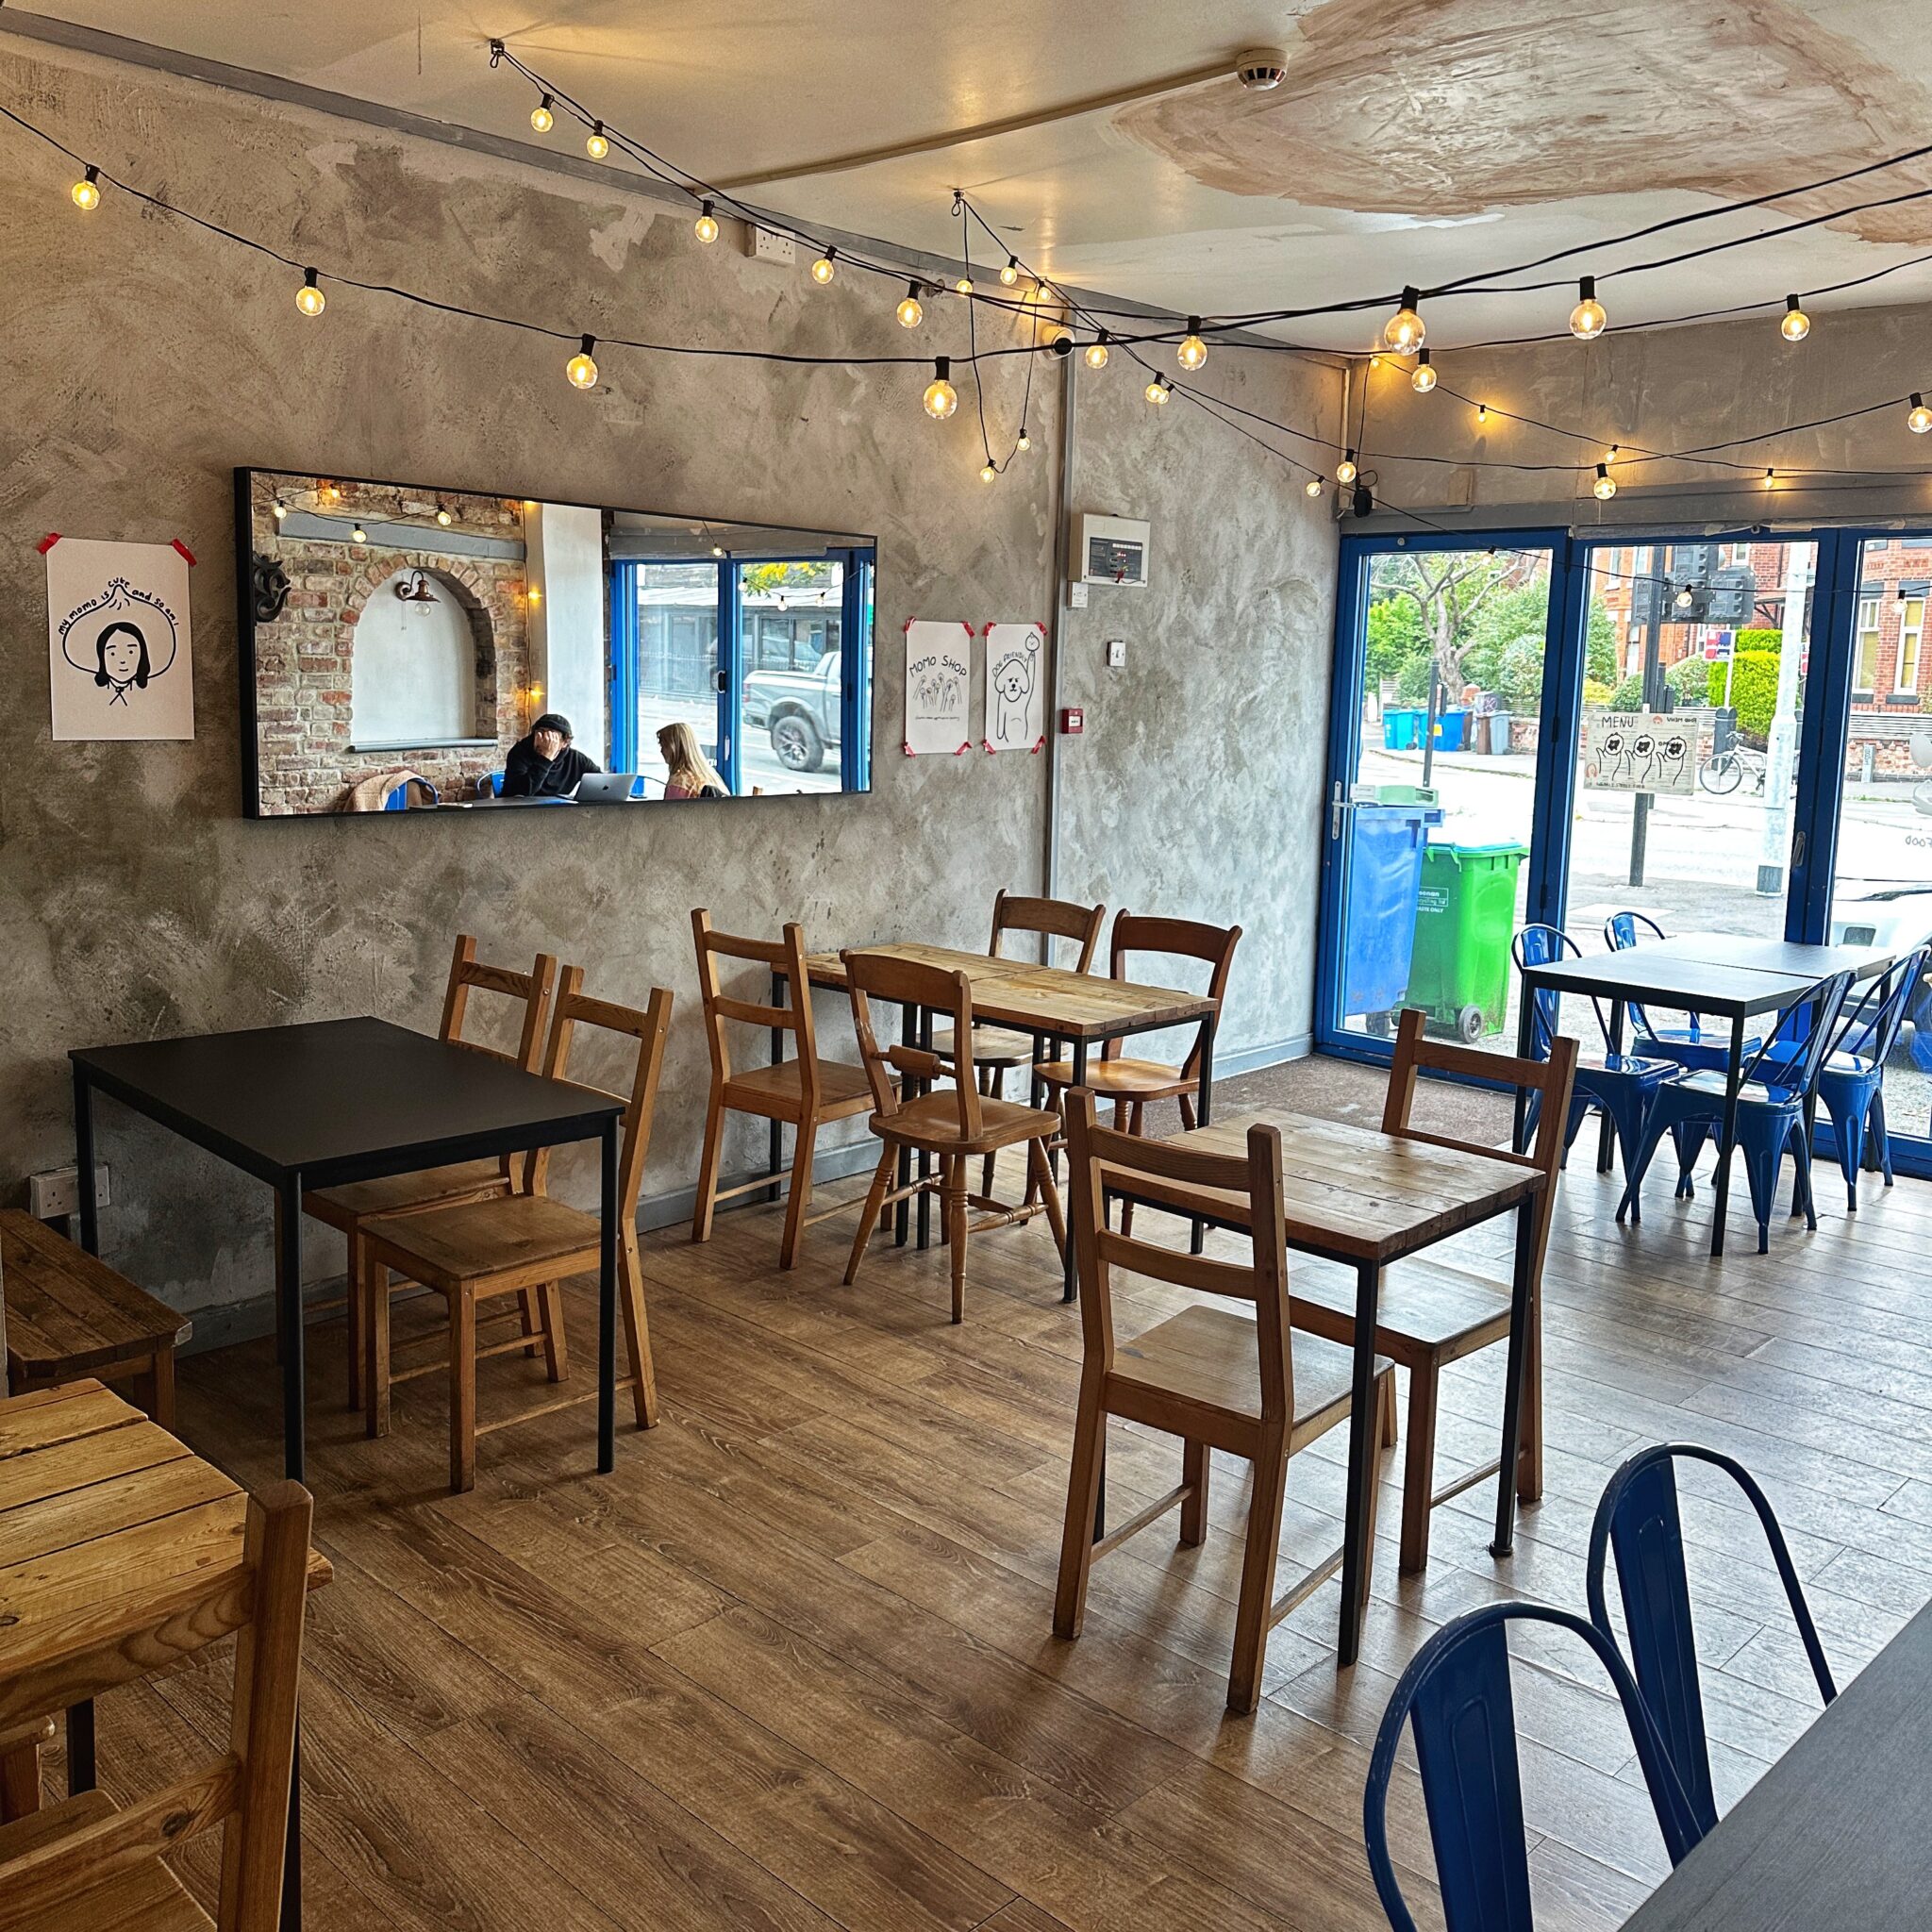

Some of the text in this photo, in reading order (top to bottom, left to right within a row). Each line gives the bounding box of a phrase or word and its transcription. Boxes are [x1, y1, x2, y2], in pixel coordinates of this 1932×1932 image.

[58, 618, 71, 635] my
[69, 599, 97, 620] momo
[101, 591, 110, 601] is
[108, 576, 131, 589] cute
[132, 590, 152, 602] and
[154, 598, 165, 608] so
[165, 608, 176, 621] am
[908, 655, 967, 677] MOMO SHOP
[991, 651, 1027, 677] DOG FRIENDLY
[1601, 716, 1634, 728] MENU
